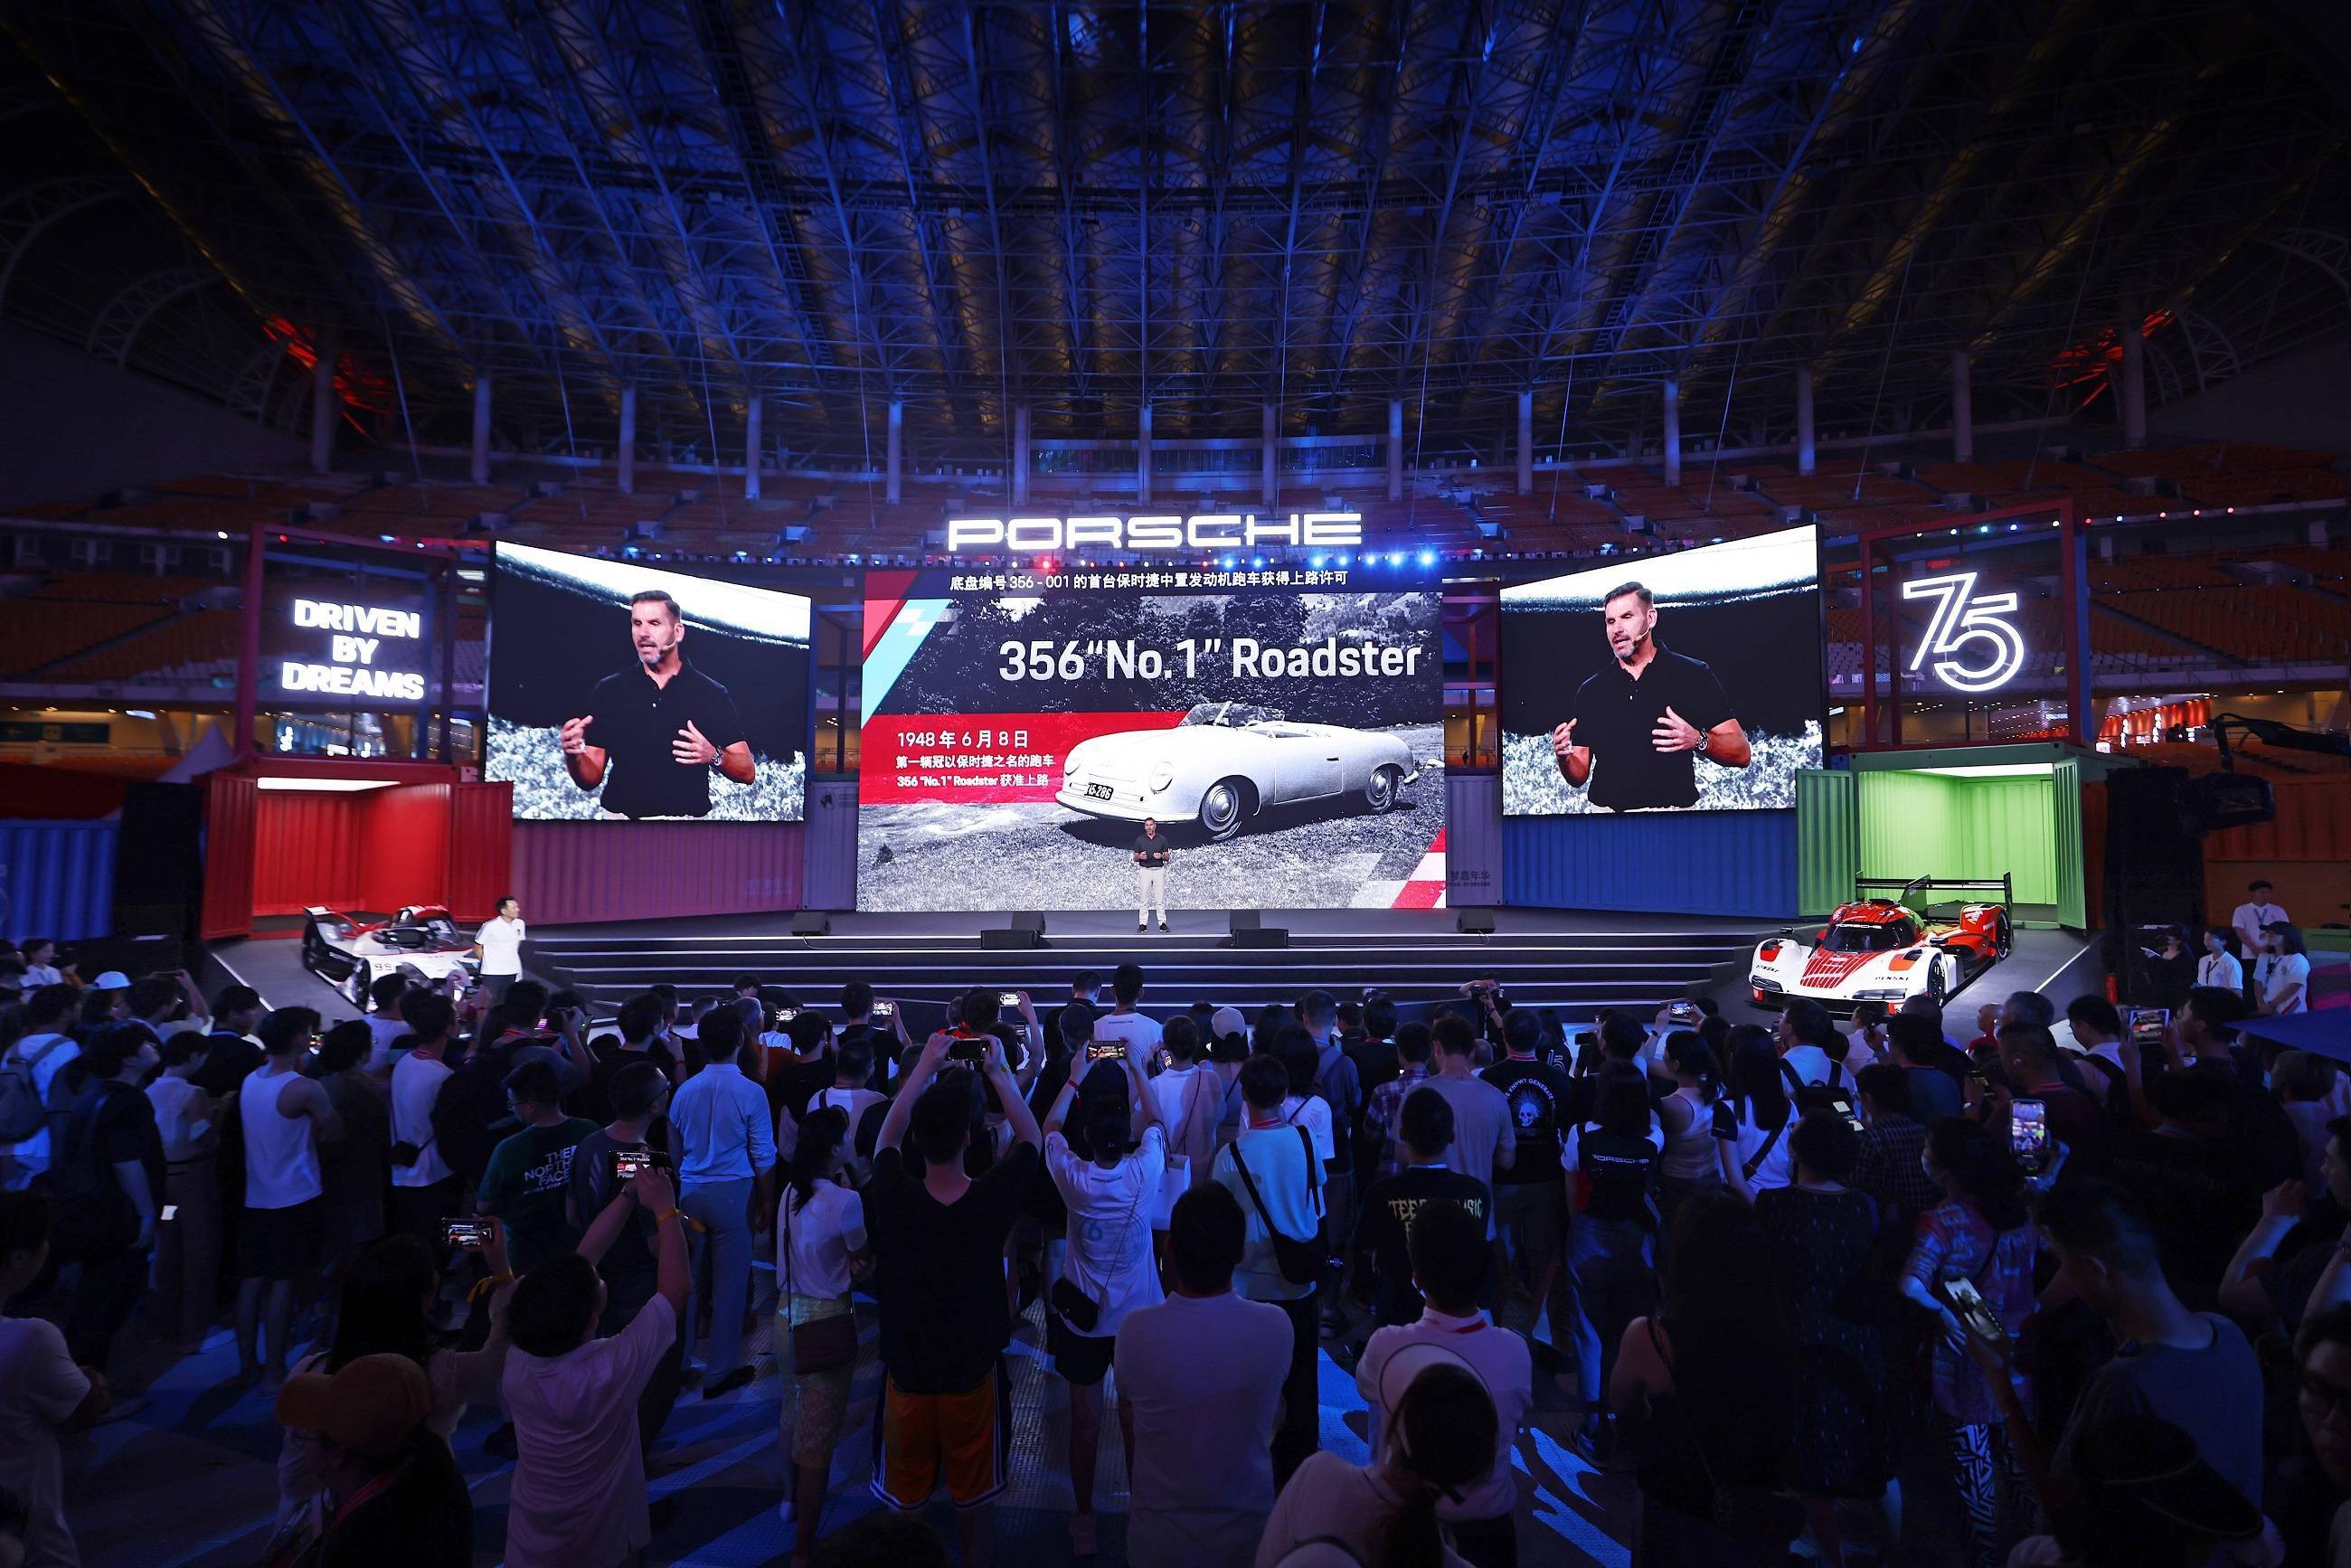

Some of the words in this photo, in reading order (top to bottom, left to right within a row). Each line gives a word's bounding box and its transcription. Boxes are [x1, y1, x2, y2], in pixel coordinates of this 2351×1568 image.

[948, 513, 1362, 551] PORSCHE
[949, 575, 1006, 591] 底盘编号
[1010, 575, 1034, 589] 356
[1045, 574, 1069, 588] 001
[1073, 570, 1347, 590] 的首台保时捷中置发动机跑车获得上路许可
[294, 599, 420, 639] DRIVEN
[1903, 571, 2025, 693] 75
[332, 634, 379, 665] BY
[1232, 637, 1421, 678] Roadster
[281, 662, 424, 700] DREAMS
[897, 732, 935, 748] 1948
[938, 730, 956, 748] 年
[961, 732, 972, 747] 6
[976, 730, 992, 749] 月
[998, 731, 1008, 747] 8
[1015, 731, 1028, 748] 日
[896, 754, 1054, 769] 第一辆冠以保时捷之名的跑车
[897, 775, 919, 788] 356
[954, 775, 997, 787] Roadster
[999, 773, 1049, 787] 获准上路
[545, 1147, 571, 1164] THE
[524, 1159, 571, 1182] NORTH
[538, 1167, 571, 1187] FACE
